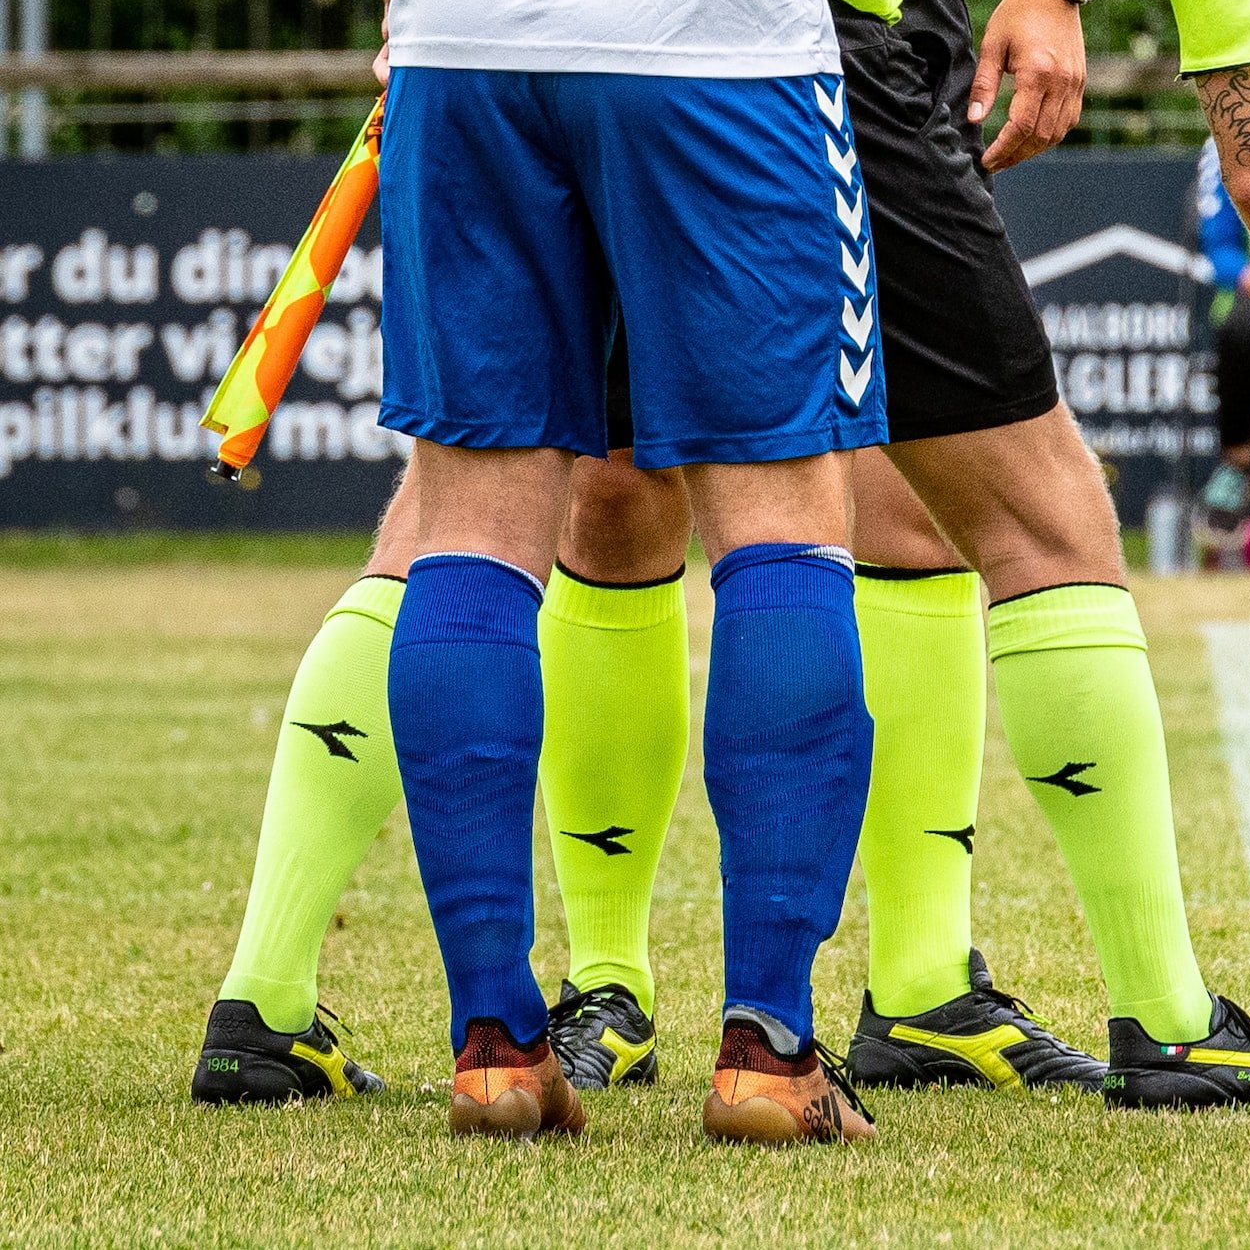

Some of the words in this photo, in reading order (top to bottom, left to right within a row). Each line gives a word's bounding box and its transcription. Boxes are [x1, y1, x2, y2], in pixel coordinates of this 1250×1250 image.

[51, 228, 160, 304] du
[160, 307, 237, 383] vi
[206, 1057, 240, 1073] 1984
